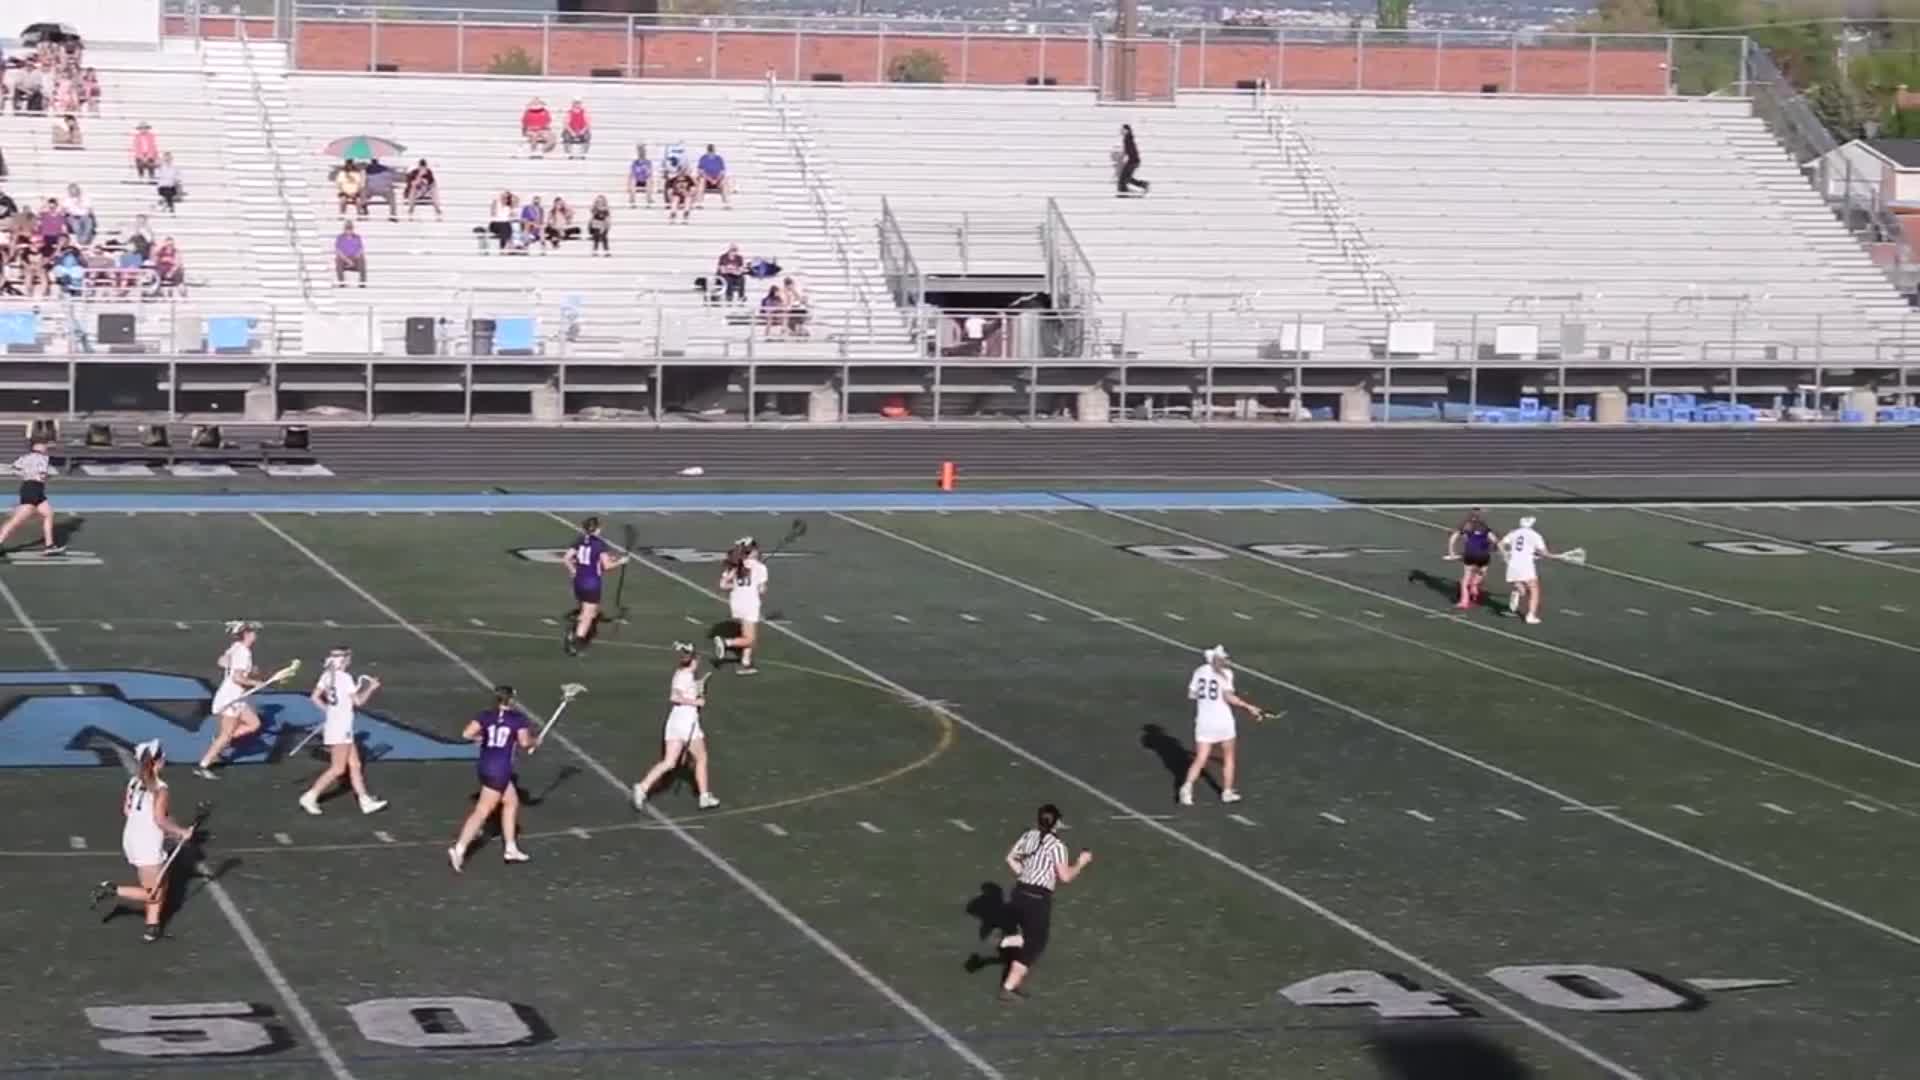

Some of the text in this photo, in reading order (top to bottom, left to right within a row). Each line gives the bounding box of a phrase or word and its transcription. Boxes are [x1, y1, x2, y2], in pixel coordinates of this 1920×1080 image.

[1198, 677, 1218, 701] 28
[487, 716, 511, 748] 10
[1278, 962, 1698, 1019] 40
[85, 995, 545, 1057] 50
